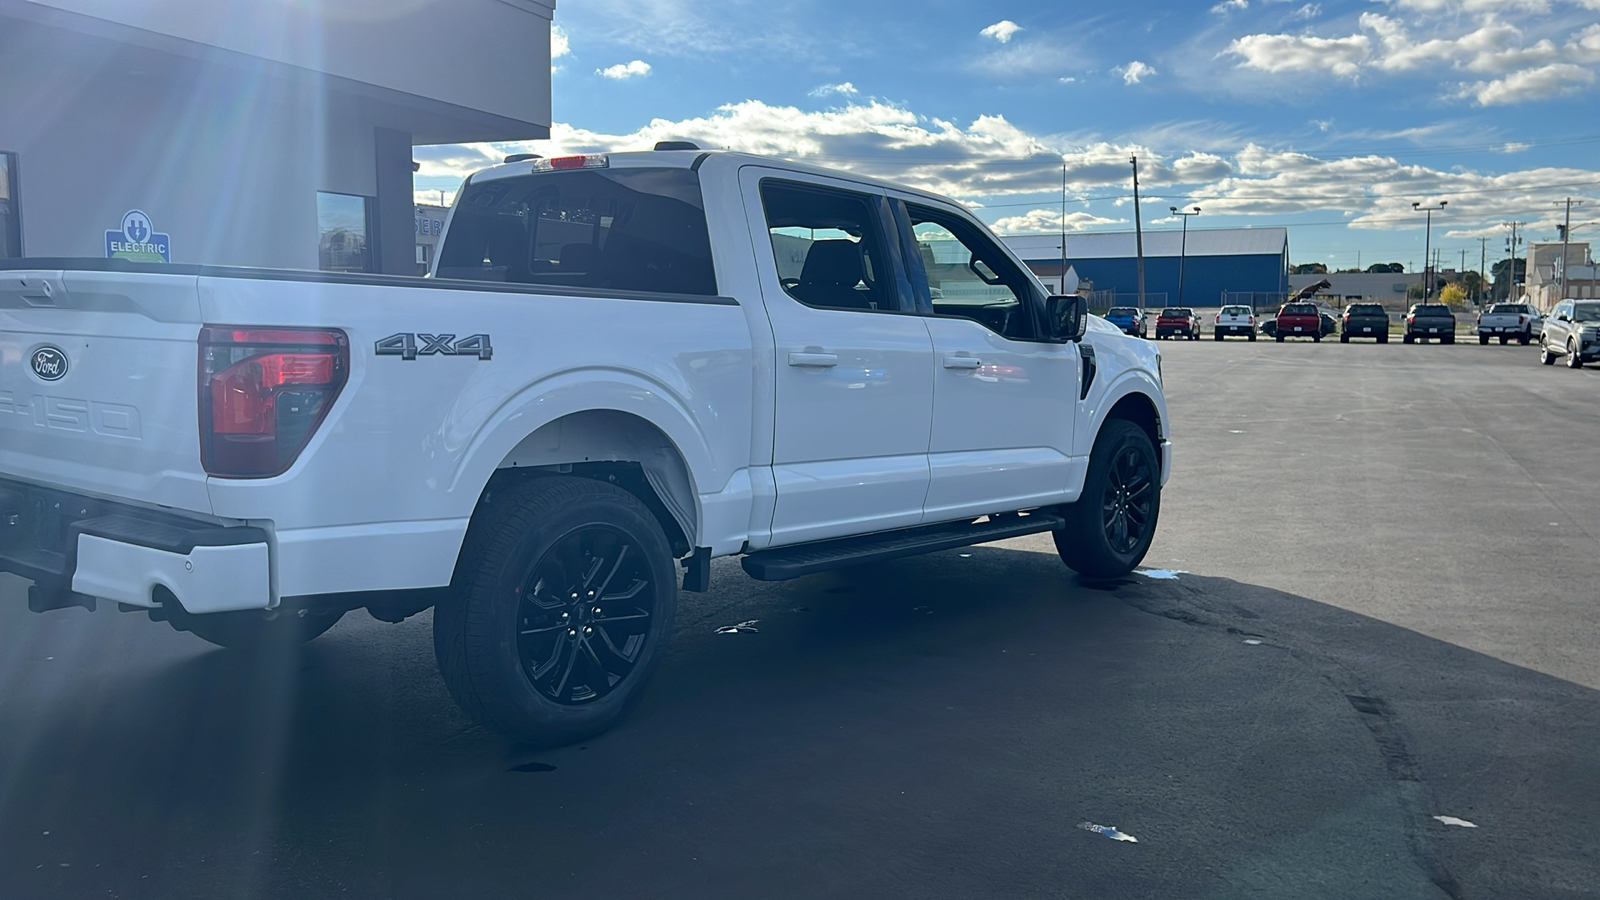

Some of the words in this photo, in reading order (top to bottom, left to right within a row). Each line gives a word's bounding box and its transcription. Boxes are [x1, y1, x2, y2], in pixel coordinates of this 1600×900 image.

[110, 241, 166, 254] ELECTRIC
[374, 332, 493, 361] 4X4
[34, 350, 61, 376] Ford
